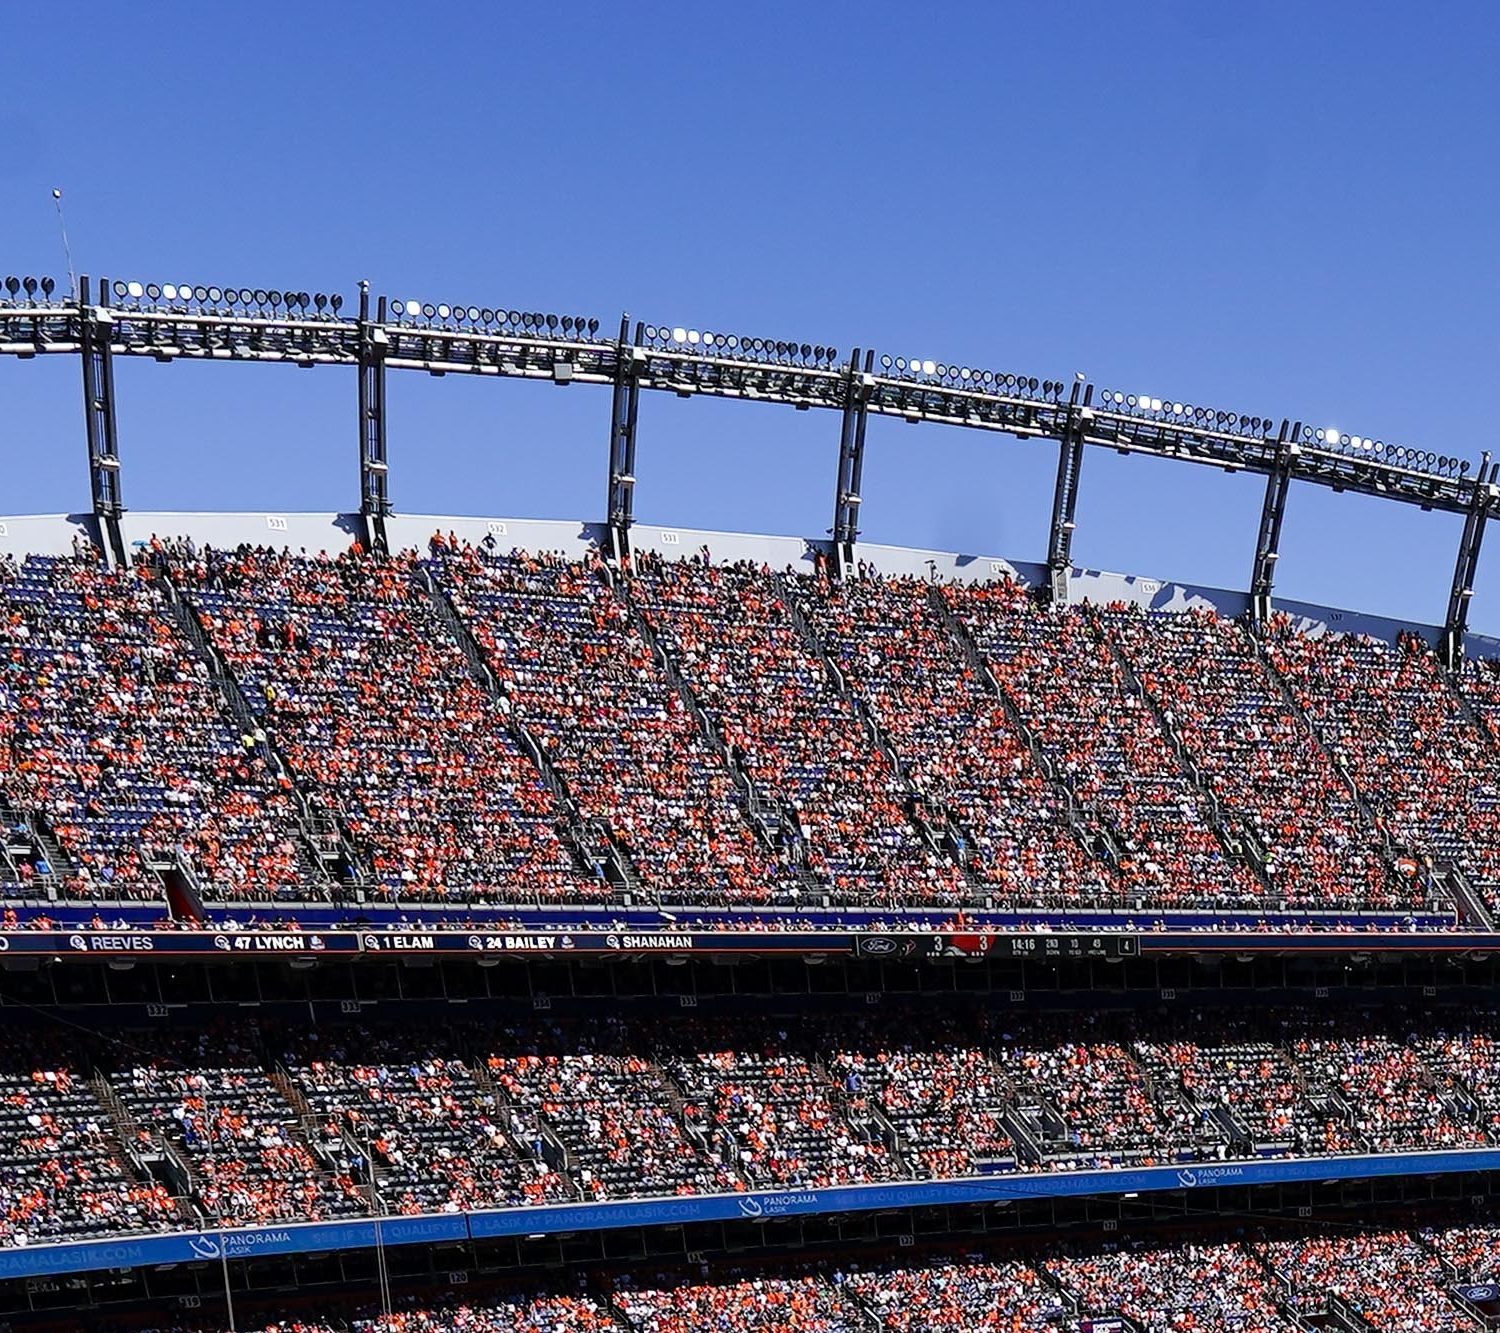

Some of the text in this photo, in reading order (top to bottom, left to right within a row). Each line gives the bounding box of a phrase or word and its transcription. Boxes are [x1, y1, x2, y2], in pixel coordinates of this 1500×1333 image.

[91, 935, 153, 950] REEVES
[234, 934, 305, 949] 47 LYNCH
[393, 936, 434, 949] ELAM
[486, 936, 556, 950] 24 BAILEY
[622, 935, 693, 949] SHANAHAN
[934, 936, 943, 951] 3
[979, 936, 988, 950] 3
[1011, 938, 1036, 950] 14:16
[1196, 1168, 1244, 1180] PANORAMA
[763, 1195, 818, 1208] PANORAMA
[765, 1205, 786, 1214] LASIK
[391, 1204, 699, 1239] QUALIFY LASIK PANORAMALASIK.COM
[221, 1231, 291, 1247] PANORAMA
[225, 1244, 251, 1254] LASIK
[451, 1273, 466, 1283] 120
